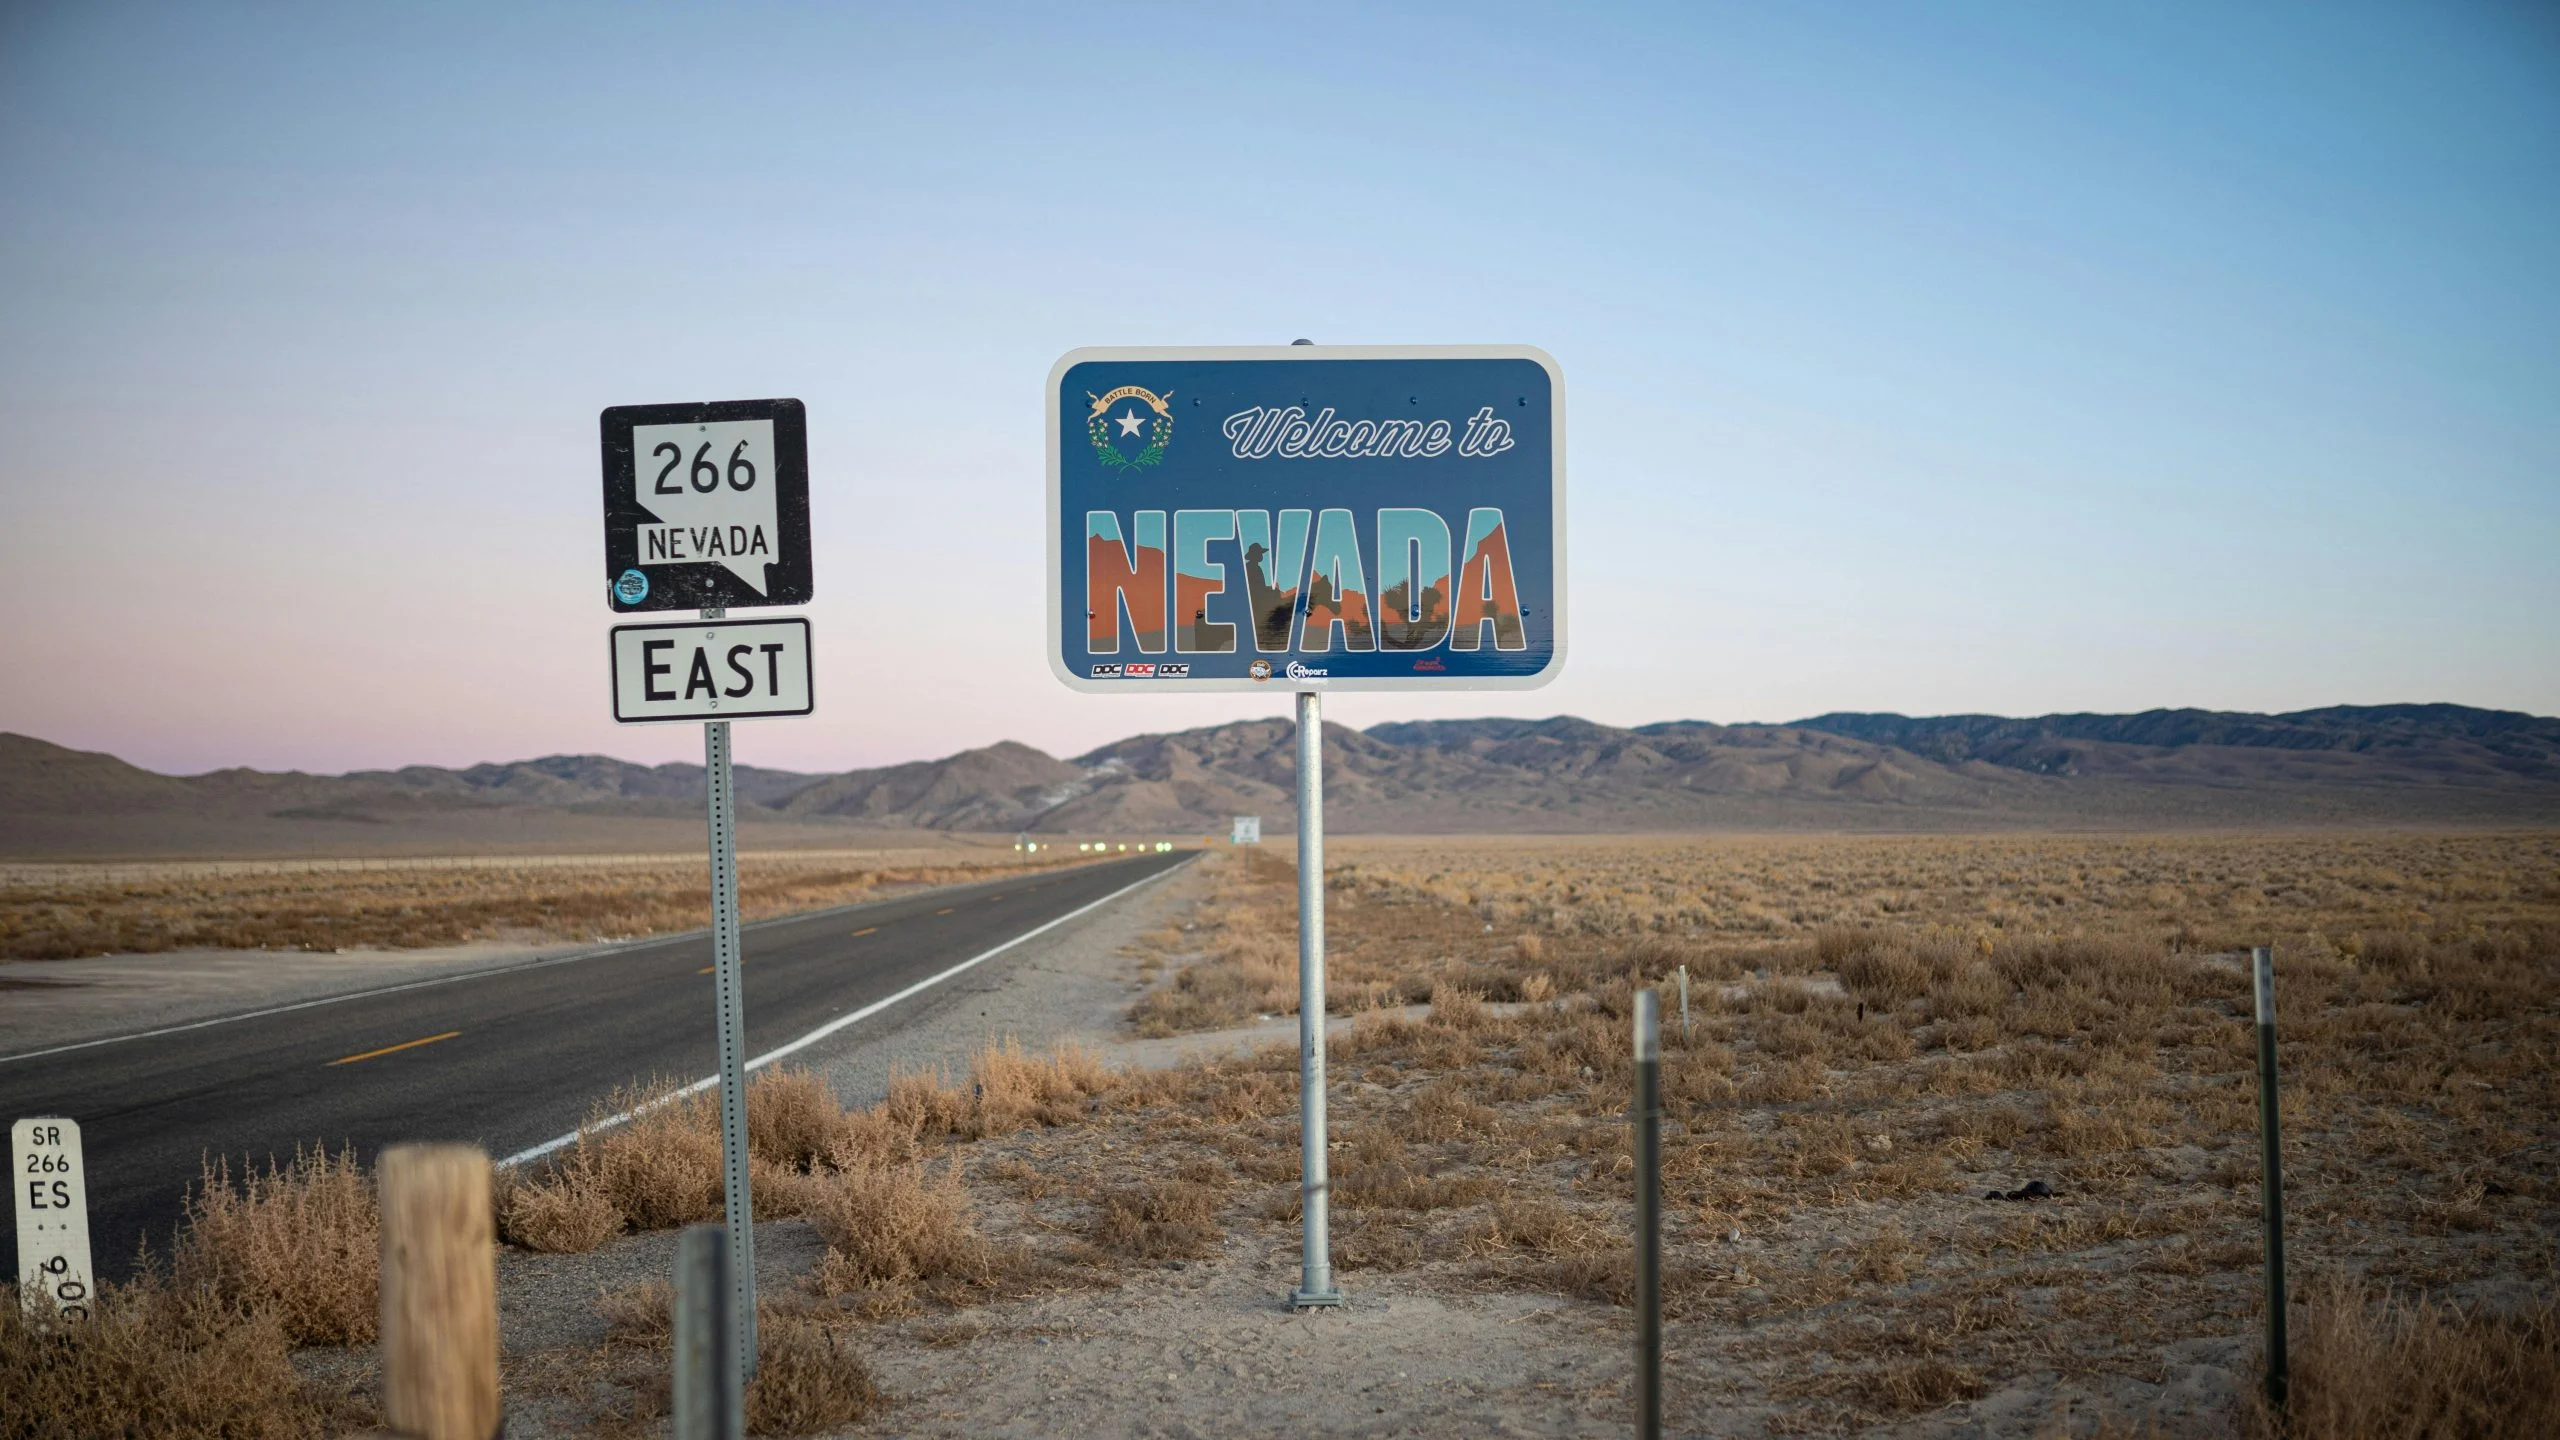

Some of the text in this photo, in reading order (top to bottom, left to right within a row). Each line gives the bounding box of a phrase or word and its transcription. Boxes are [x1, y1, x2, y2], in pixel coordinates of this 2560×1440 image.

[1104, 387, 1157, 404] BATTLE BORN
[1222, 405, 1515, 460] Welcome to
[652, 439, 757, 495] 266
[647, 524, 769, 560] NEVADA
[1086, 507, 1527, 654] NEVADA
[643, 639, 784, 701] EAST
[32, 1126, 61, 1146] SR
[26, 1154, 70, 1173] 266
[29, 1180, 71, 1209] ES
